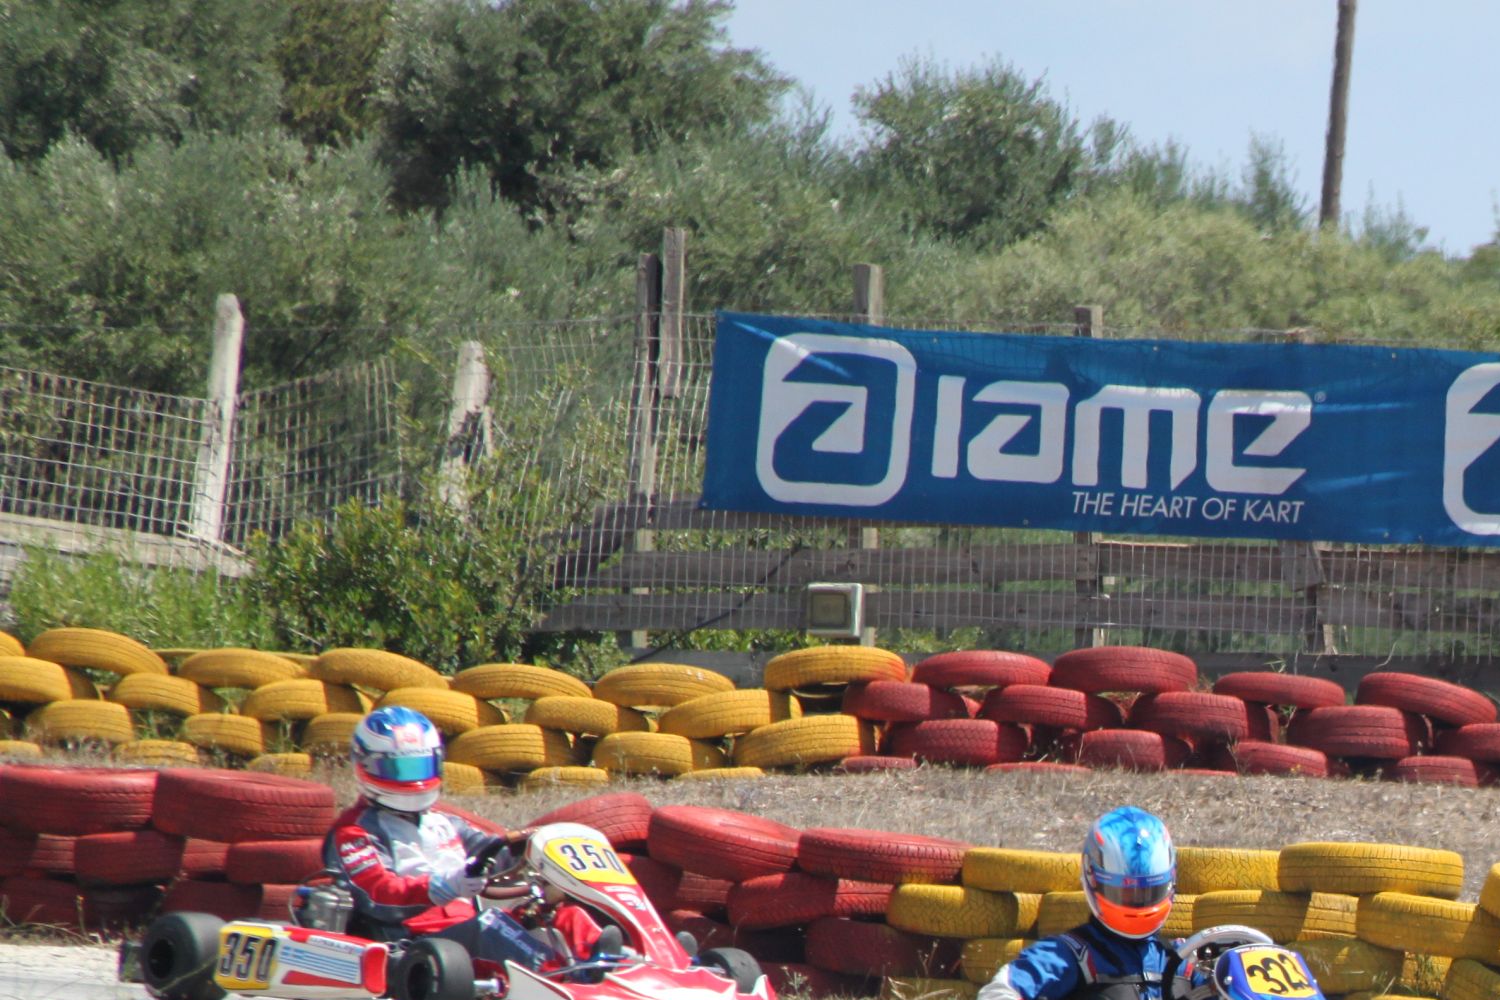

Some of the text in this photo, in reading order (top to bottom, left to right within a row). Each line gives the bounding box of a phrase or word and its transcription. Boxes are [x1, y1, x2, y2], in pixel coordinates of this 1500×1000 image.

[1072, 491, 1305, 524] THE HEART OF KART
[558, 842, 625, 875] 350
[219, 931, 279, 982] 350
